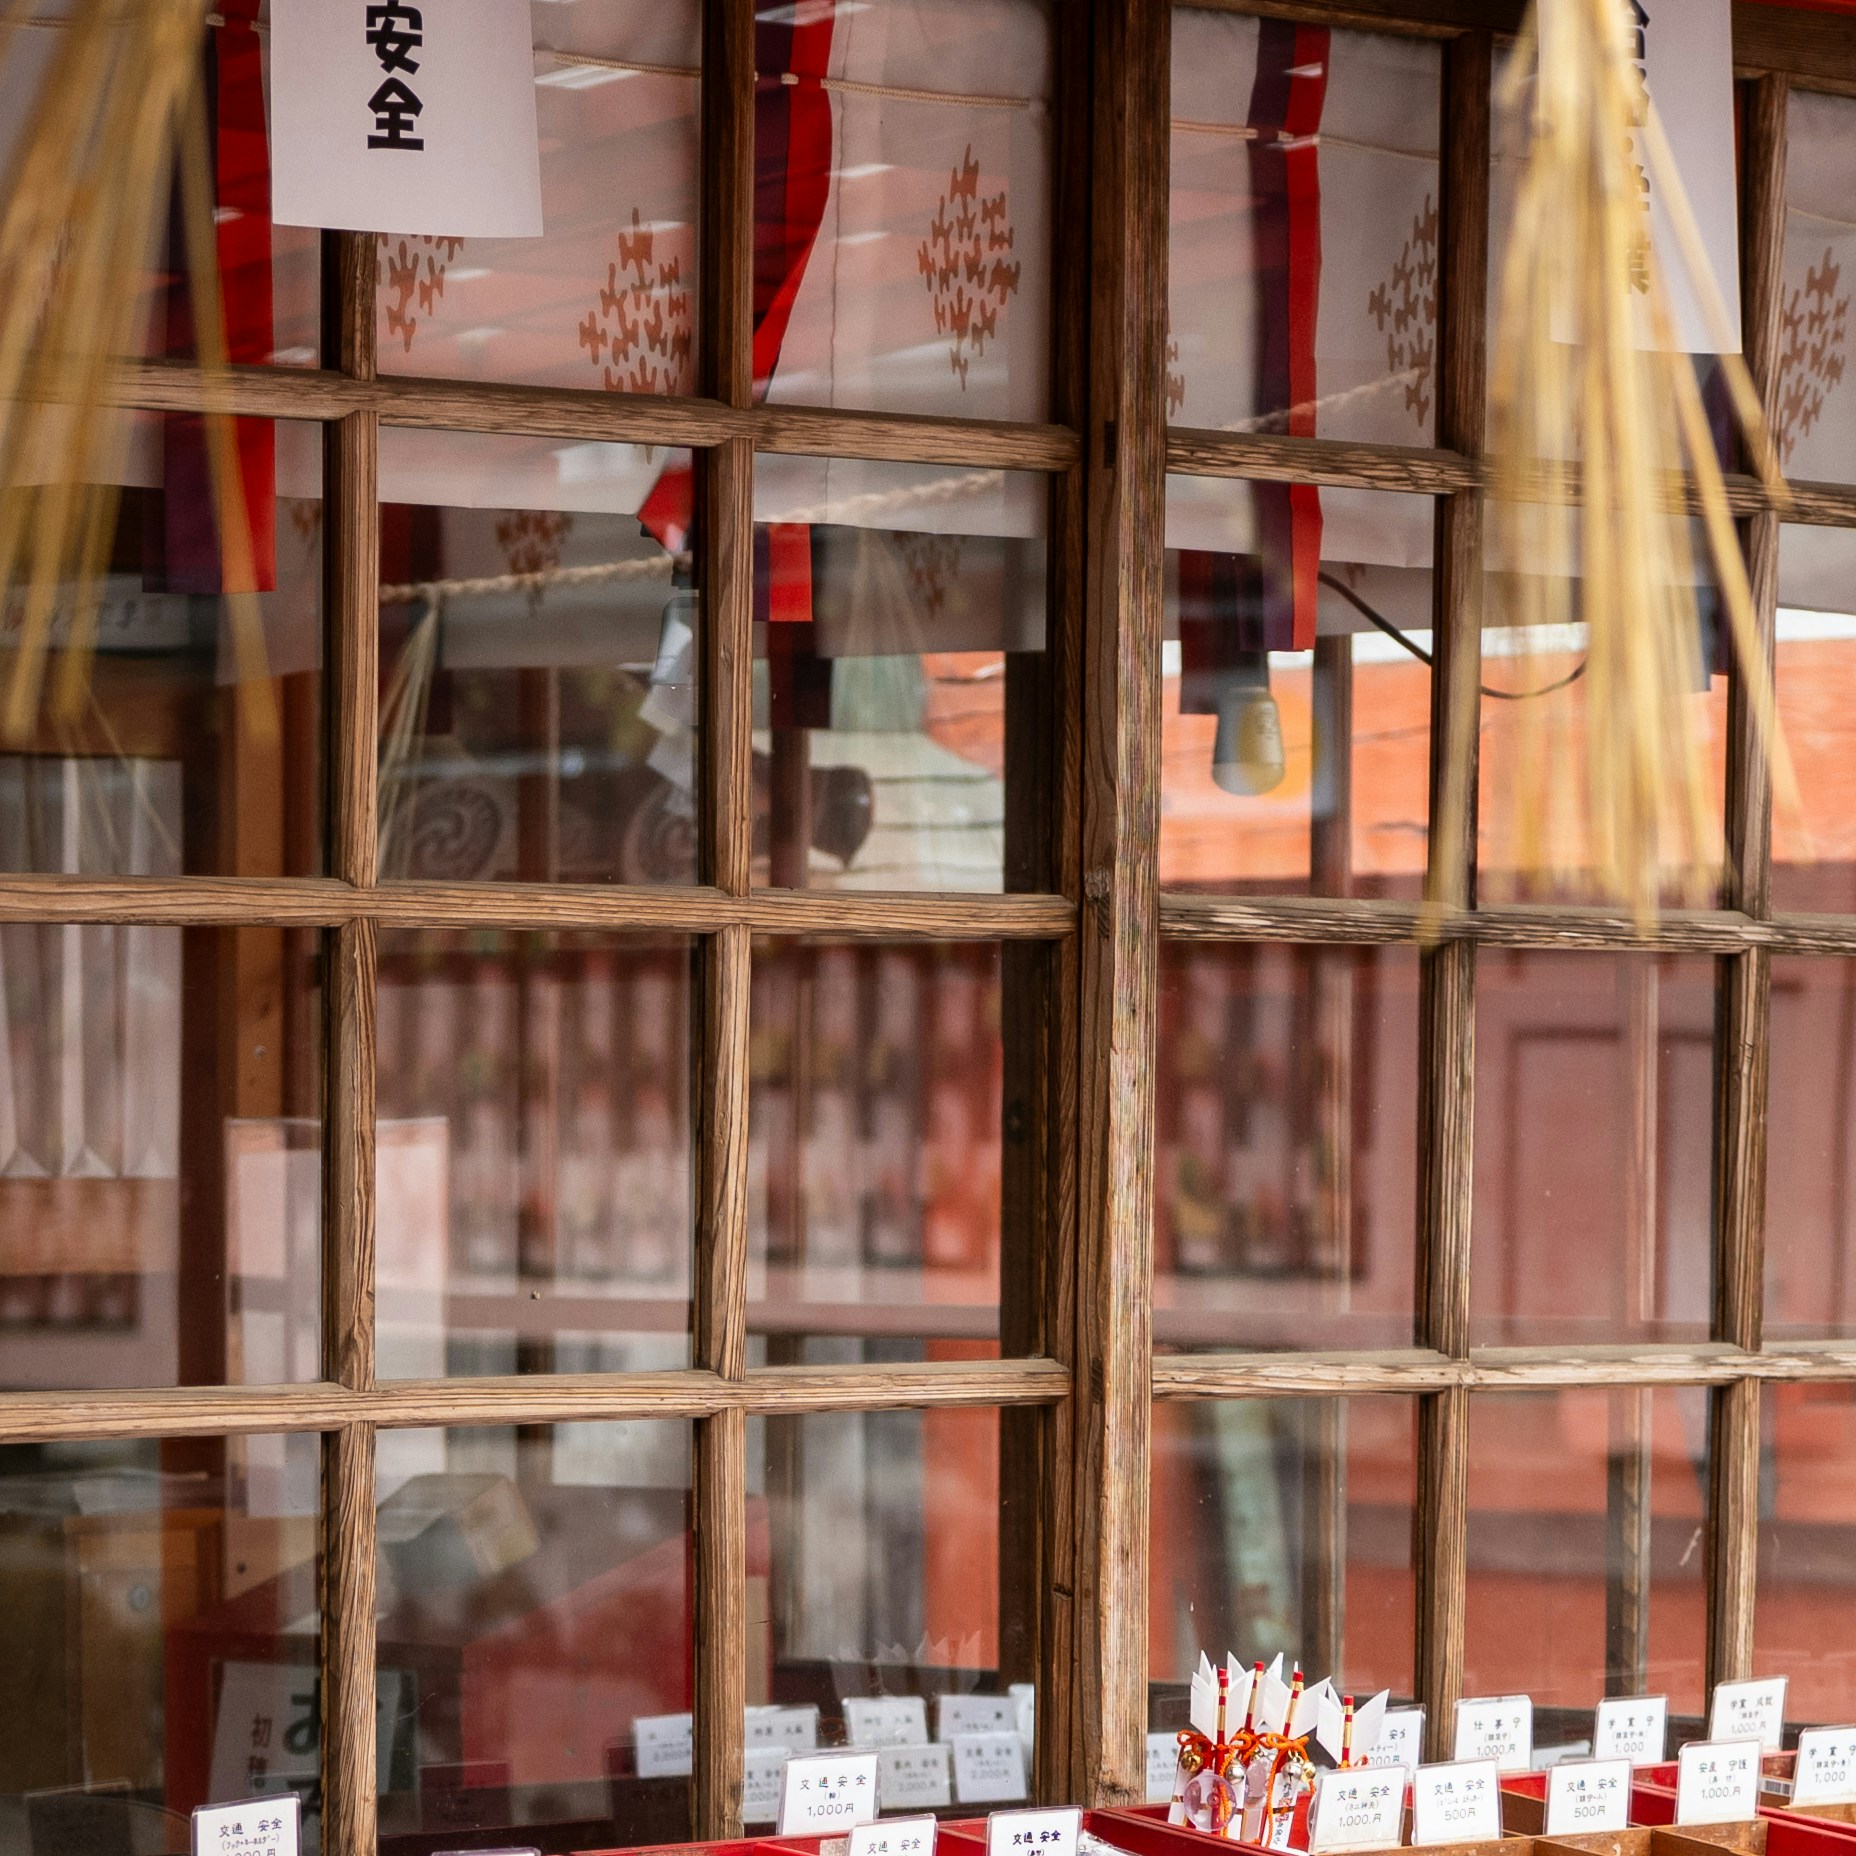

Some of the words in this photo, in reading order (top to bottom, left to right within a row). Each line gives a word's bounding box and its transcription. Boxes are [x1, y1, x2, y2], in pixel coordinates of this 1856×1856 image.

[366, 0, 424, 151] 安全
[799, 1773, 867, 1791] 交通安全
[1434, 1782, 1454, 1796] 交通
[1464, 1778, 1485, 1791] 安全
[1566, 1778, 1586, 1793] 交通
[1597, 1776, 1617, 1790] 安全
[1336, 1787, 1358, 1801] 交通
[1369, 1785, 1390, 1798] 安全
[807, 1802, 854, 1817] 1,000円
[1444, 1807, 1477, 1821] 500円
[1574, 1805, 1606, 1818] 500円
[219, 1822, 245, 1838] 交通
[257, 1817, 283, 1833] 安全
[867, 1841, 889, 1855] 交通
[900, 1837, 921, 1851] 安全
[1012, 1831, 1034, 1846] 交通
[1039, 1829, 1062, 1843] 安全
